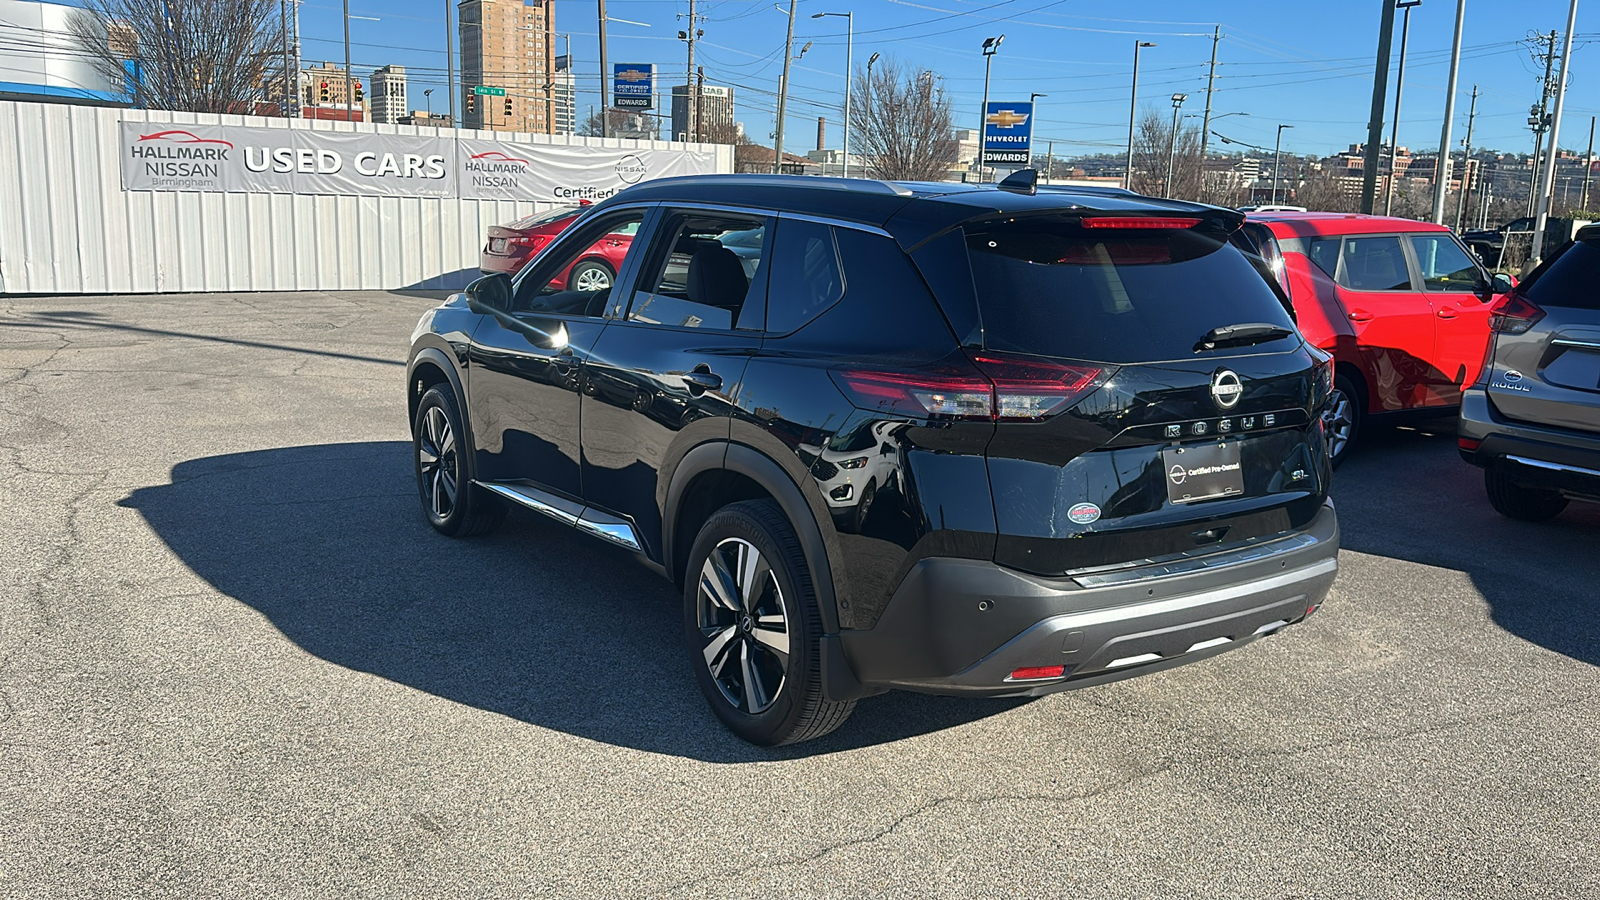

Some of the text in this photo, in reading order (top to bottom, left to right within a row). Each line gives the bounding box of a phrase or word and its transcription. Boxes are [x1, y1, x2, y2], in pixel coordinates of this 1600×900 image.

[131, 146, 229, 160] HALLMARK
[244, 146, 446, 180] USED CARS
[465, 162, 526, 174] HALLMARK
[146, 162, 218, 177] NISSAN
[152, 178, 214, 188] Birmingham
[472, 176, 518, 188] NISSAN
[553, 186, 614, 198] Certified
[1212, 385, 1243, 394] NISSAN
[1492, 381, 1531, 392] ROGUE
[1165, 414, 1275, 437] ROGUE
[1188, 467, 1212, 476] Certified
